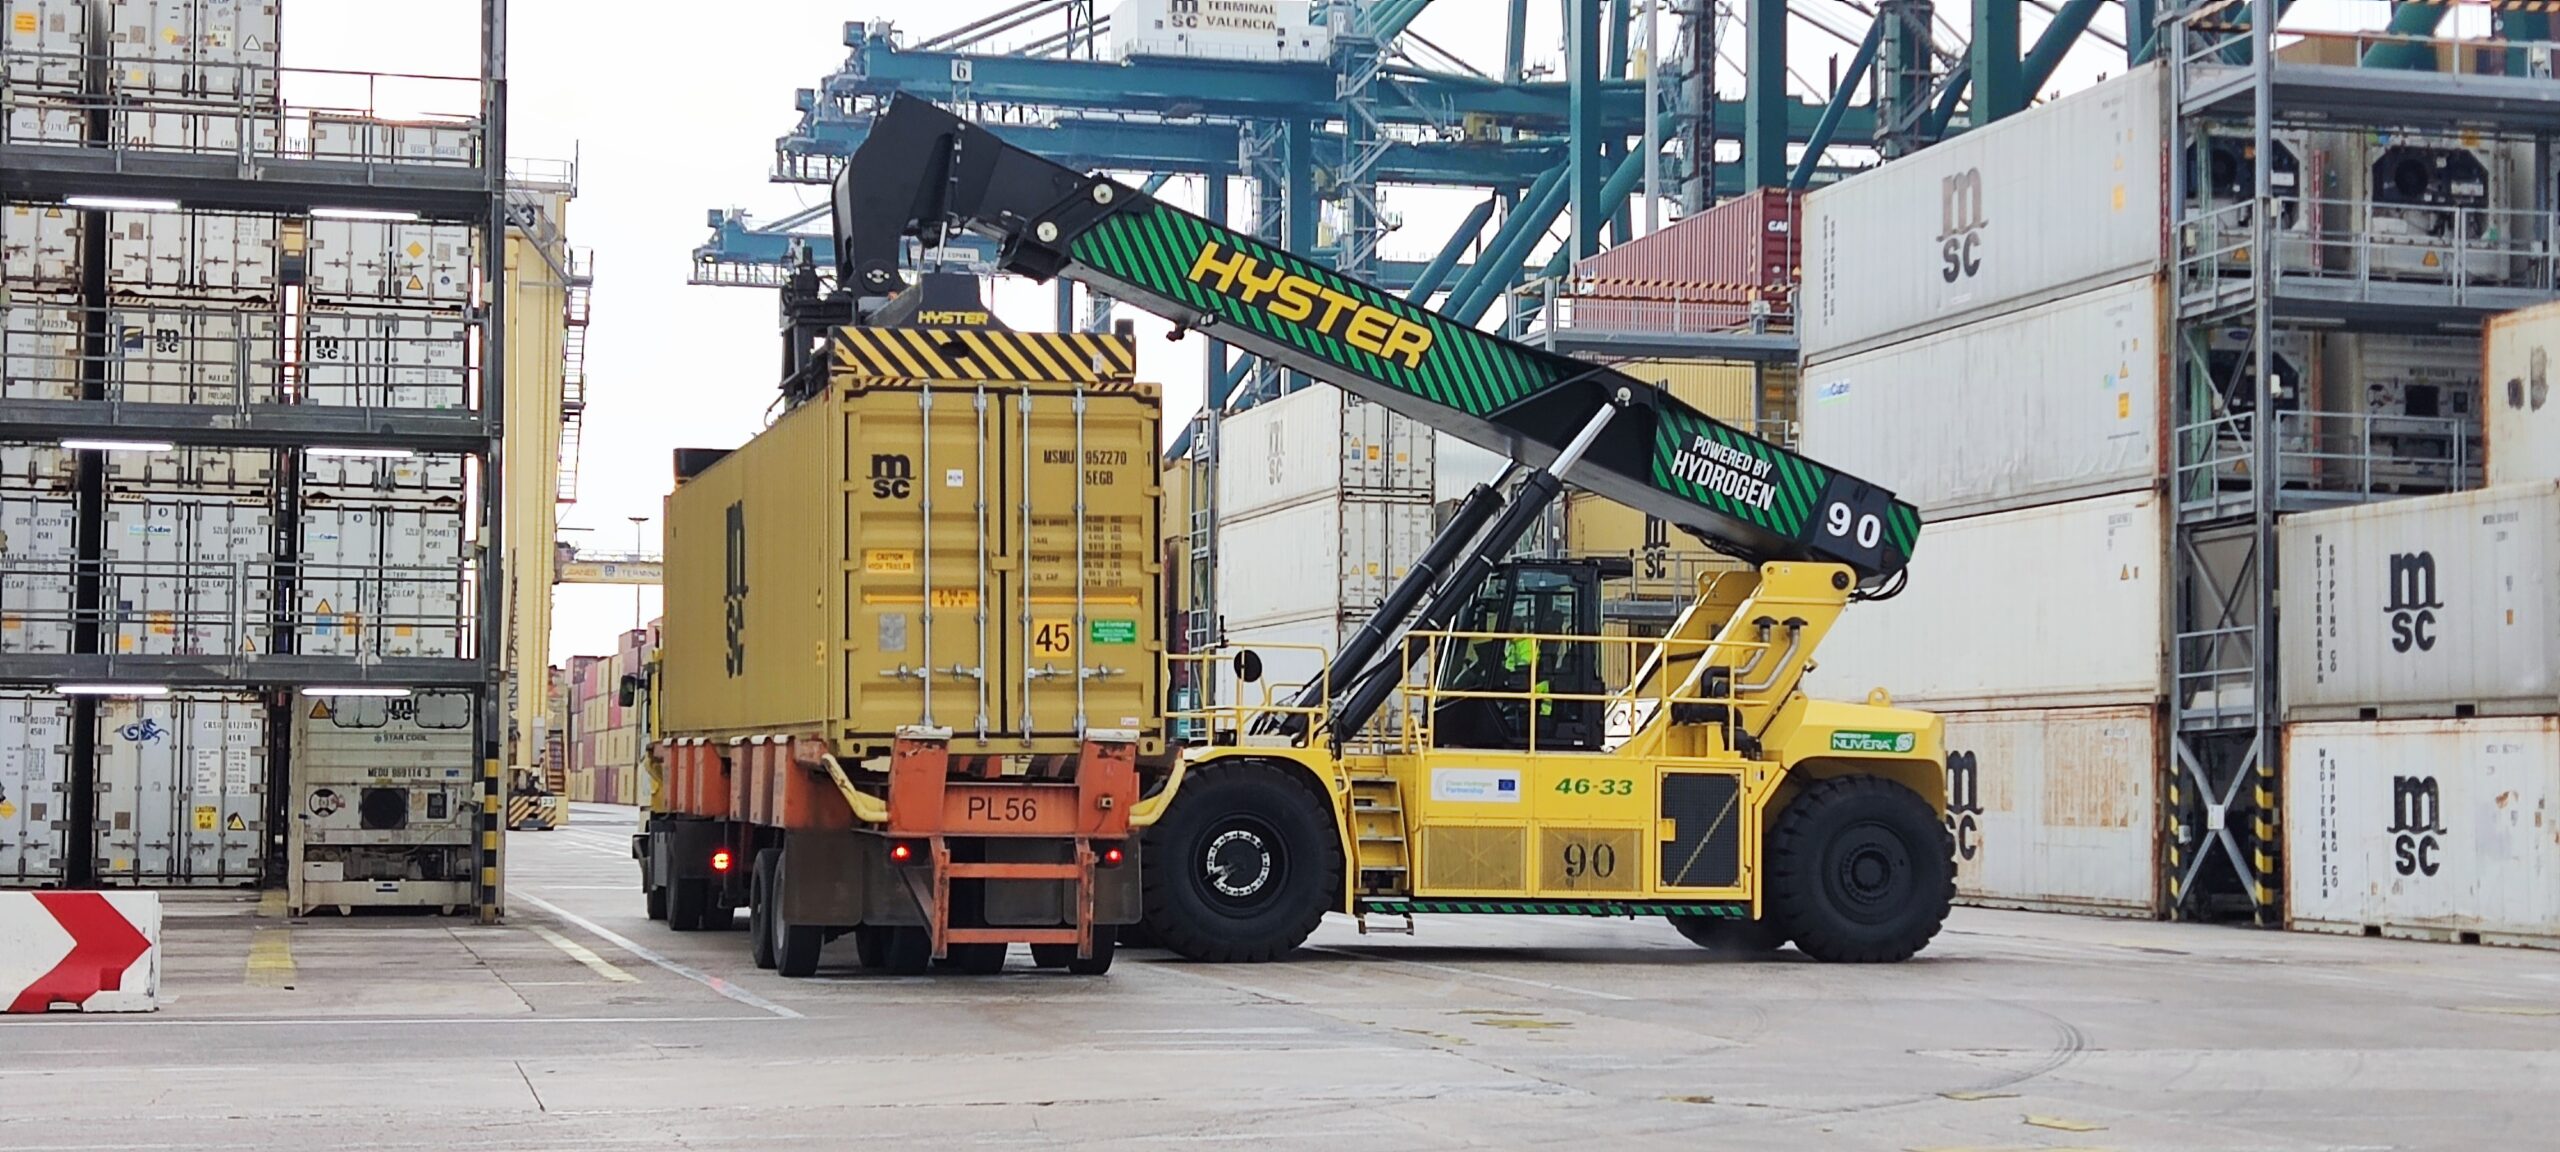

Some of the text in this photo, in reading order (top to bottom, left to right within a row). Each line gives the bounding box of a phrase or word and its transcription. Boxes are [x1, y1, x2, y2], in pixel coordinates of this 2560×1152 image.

[1206, 16, 1275, 30] VALENCIA
[1207, 0, 1276, 15] TERMINAL
[956, 61, 967, 79] 6
[918, 310, 989, 325] HYSTER
[1188, 241, 1434, 370] HYSTER
[1043, 450, 1075, 464] MSMU
[1085, 450, 1127, 465] 952270
[1692, 435, 1773, 479] POWERED BY
[1085, 470, 1114, 485] 5EGB
[1670, 449, 1777, 512] HYDROGEN
[1826, 502, 1882, 549] 90
[2315, 534, 2324, 684] MEDITERRANEAN
[2329, 544, 2337, 672] SHIPPING CO
[1036, 624, 1070, 652] 45
[1833, 739, 1892, 750] NUVERA
[1555, 778, 1633, 796] 46-33
[2319, 748, 2328, 898] MEDITERRANEAN
[2330, 759, 2339, 888] SHIPPING CO
[1564, 843, 1615, 878] 90
